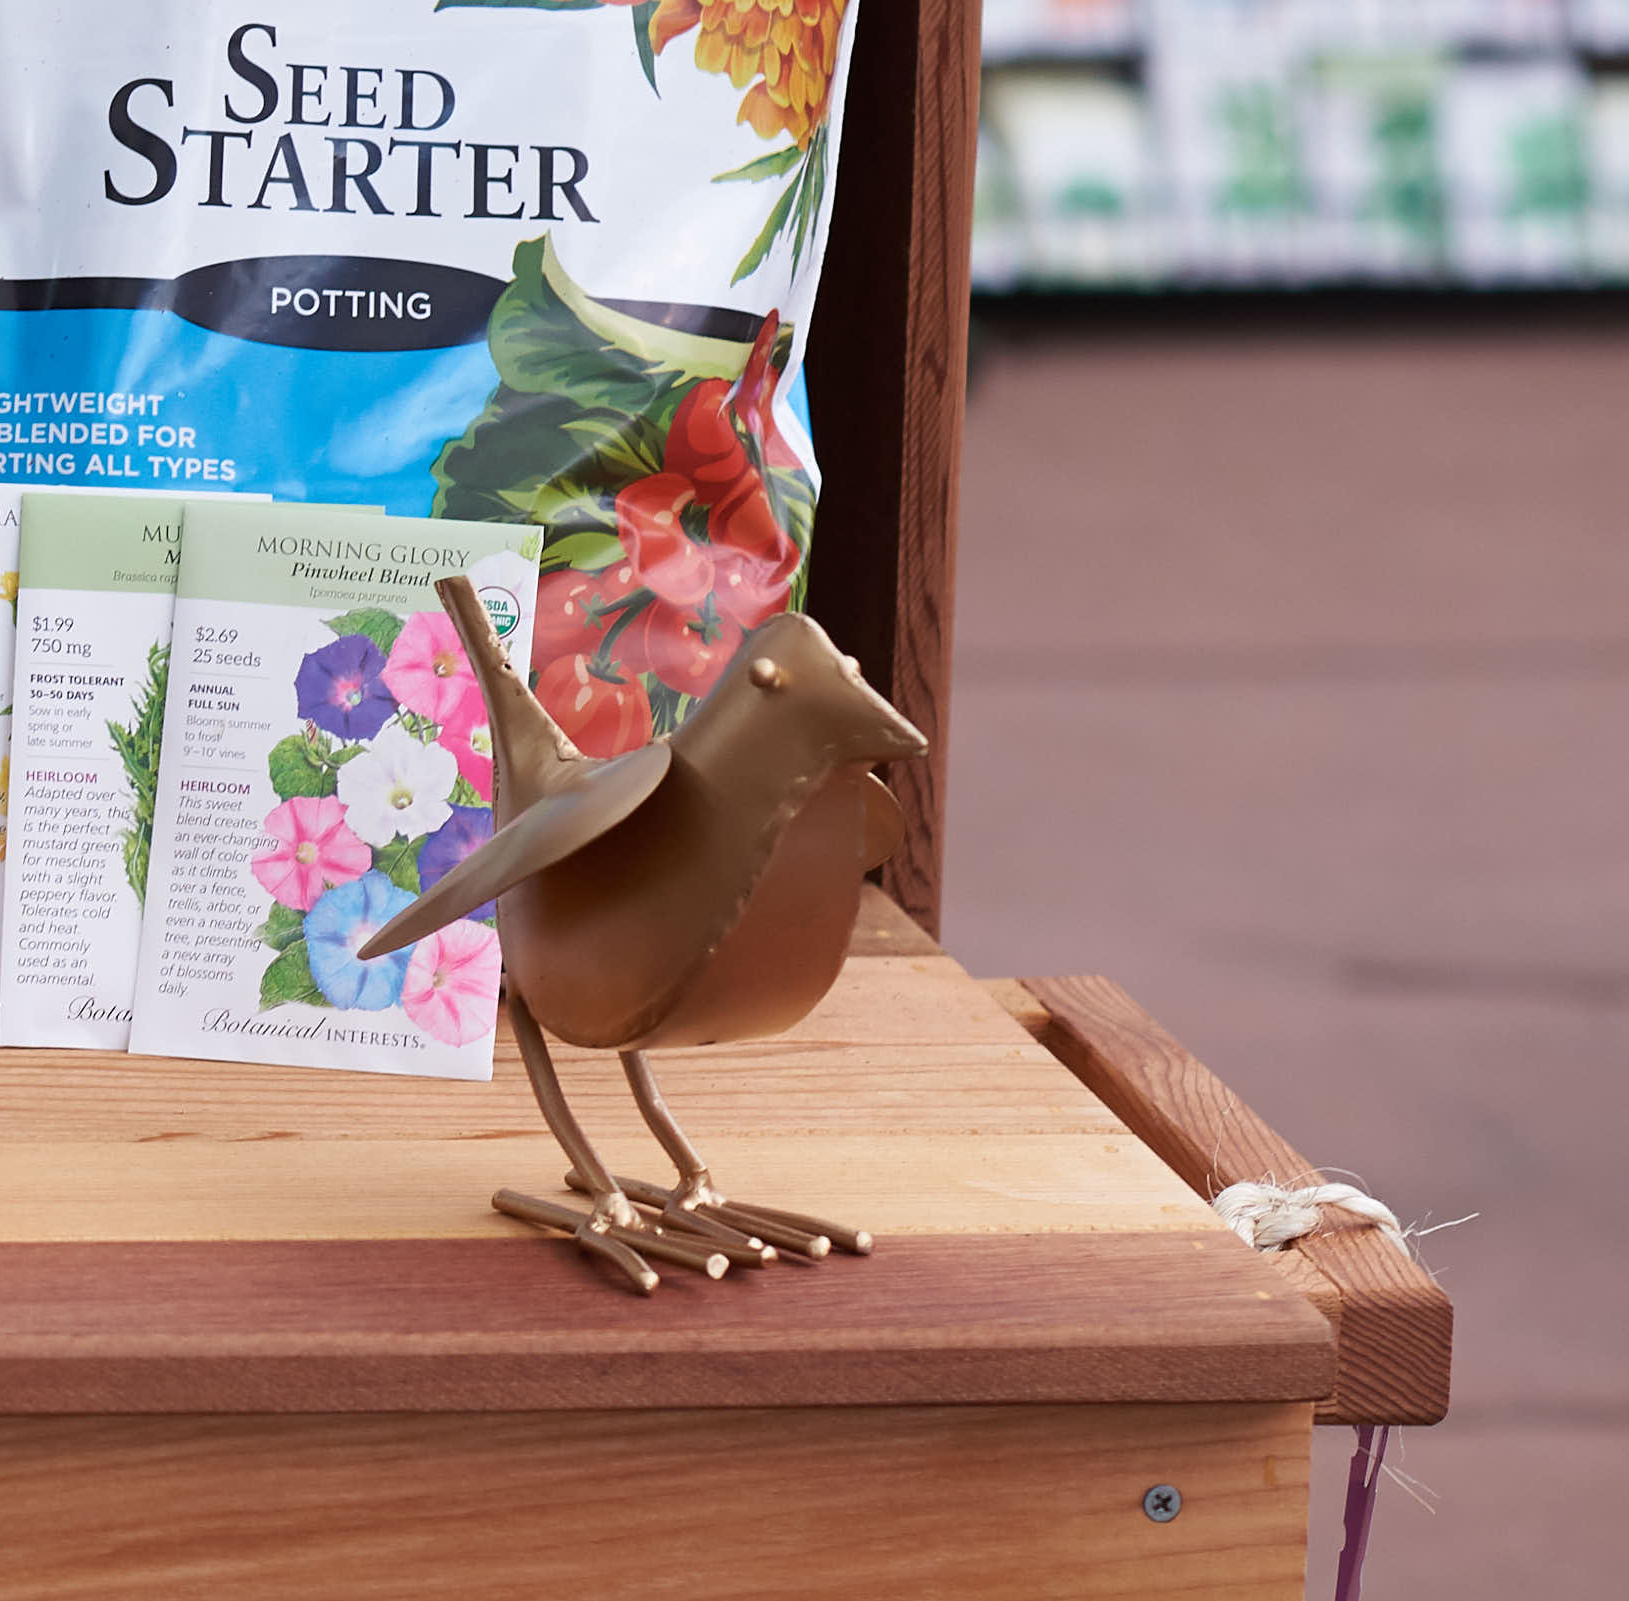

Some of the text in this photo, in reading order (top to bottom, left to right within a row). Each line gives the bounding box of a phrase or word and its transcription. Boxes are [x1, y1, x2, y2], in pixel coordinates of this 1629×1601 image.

[223, 23, 456, 132] SEED
[103, 78, 601, 224] STARTER
[270, 286, 433, 322] POTTING
[136, 426, 197, 449] FOR
[84, 453, 140, 477] ALL
[148, 455, 237, 481] TYPES
[257, 535, 471, 568] MORNING GLORY
[113, 569, 179, 587] Brassica rap
[291, 561, 432, 587] Pinwheel Blend
[32, 616, 75, 633] $1.99
[195, 626, 239, 644] $2.69
[31, 637, 92, 658] 750 mg
[193, 648, 261, 667] 25 seeds
[30, 673, 125, 687] FROST TOLERANT
[66, 689, 94, 701] DAYS
[189, 683, 235, 696] ANNUAL
[188, 699, 240, 712] FULL SUN
[26, 770, 98, 784] HEIRLOOM
[180, 780, 251, 795] HEIRLOOM
[179, 796, 243, 812] This sweet
[176, 813, 259, 830] blend creates
[174, 831, 279, 851] an ever-changing
[173, 847, 249, 864] wall of color
[171, 865, 238, 880] as it climbs
[169, 882, 247, 899] over a fence,
[168, 898, 261, 915] trellis, arbor, or
[165, 917, 253, 934] even a nearby
[164, 930, 262, 952] tree, presenting
[161, 950, 235, 968] a new array
[160, 963, 234, 982] of blossoms
[158, 981, 189, 998] daily.
[201, 1008, 419, 1048] Botanical INTERESTS
